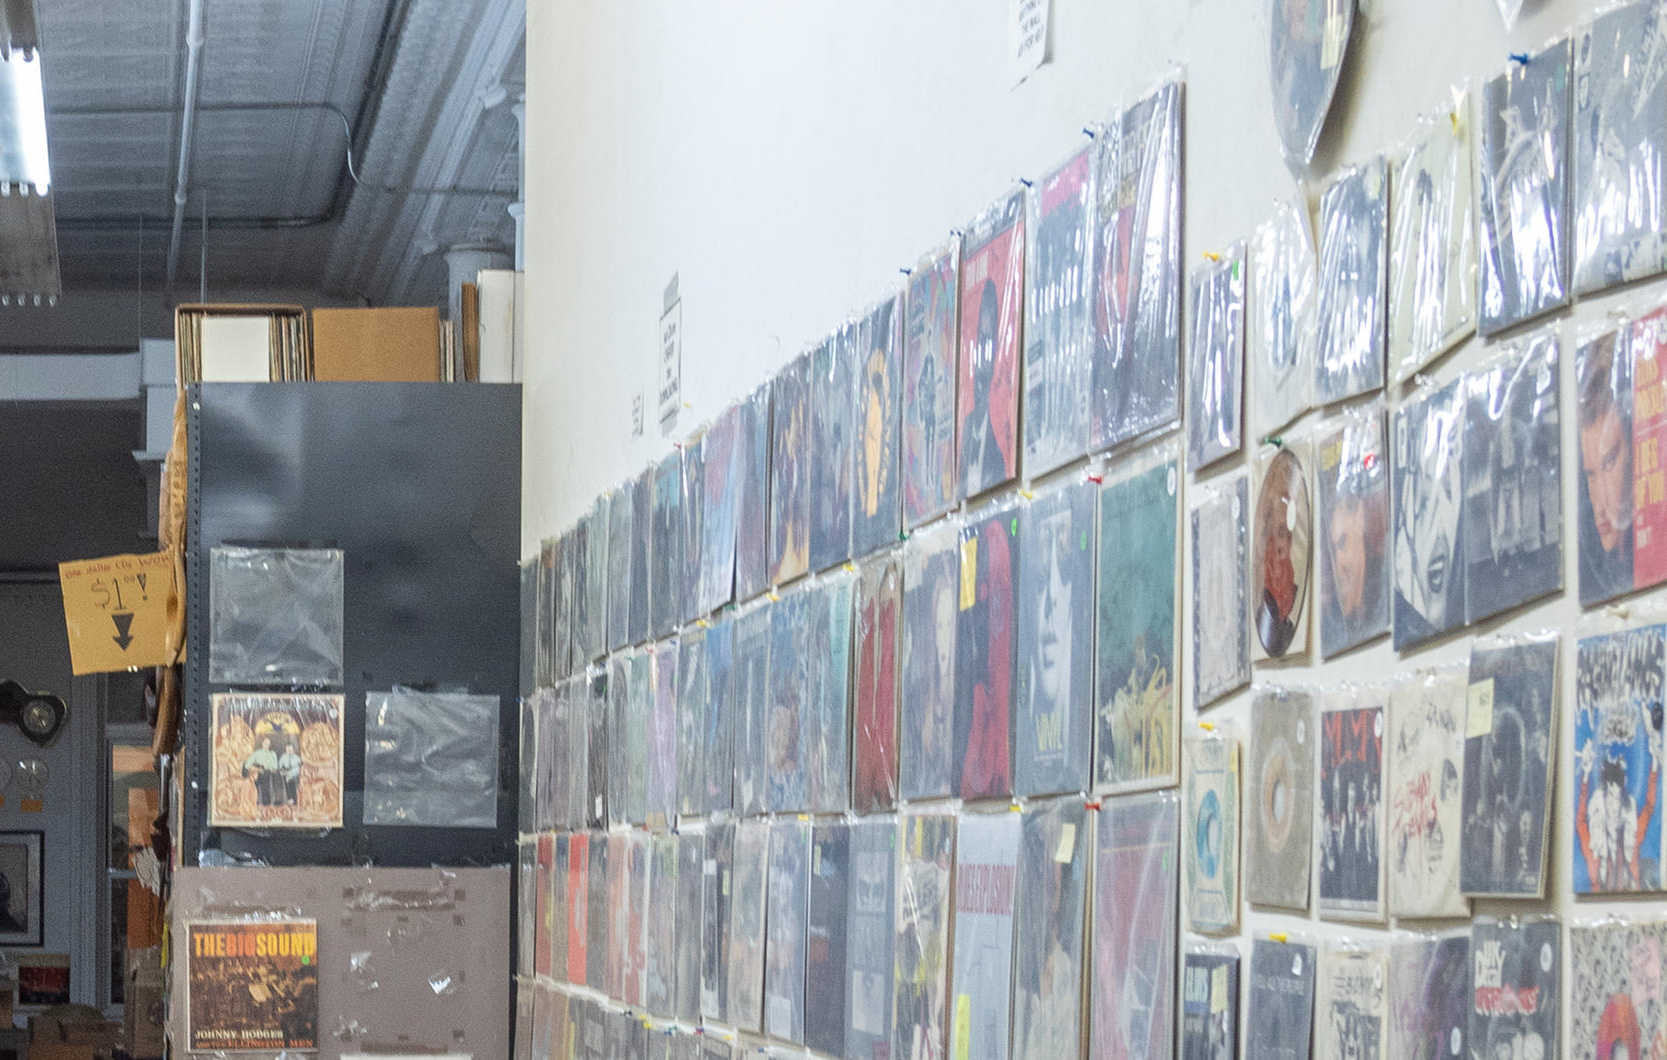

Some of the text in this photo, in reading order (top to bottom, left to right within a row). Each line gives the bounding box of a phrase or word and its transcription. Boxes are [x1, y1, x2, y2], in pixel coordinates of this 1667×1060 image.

[194, 932, 315, 957] THE BIG SOUND
[195, 1030, 284, 1039] JOHNNY HODGES
[227, 1039, 313, 1048] ELLINGTON MEN
